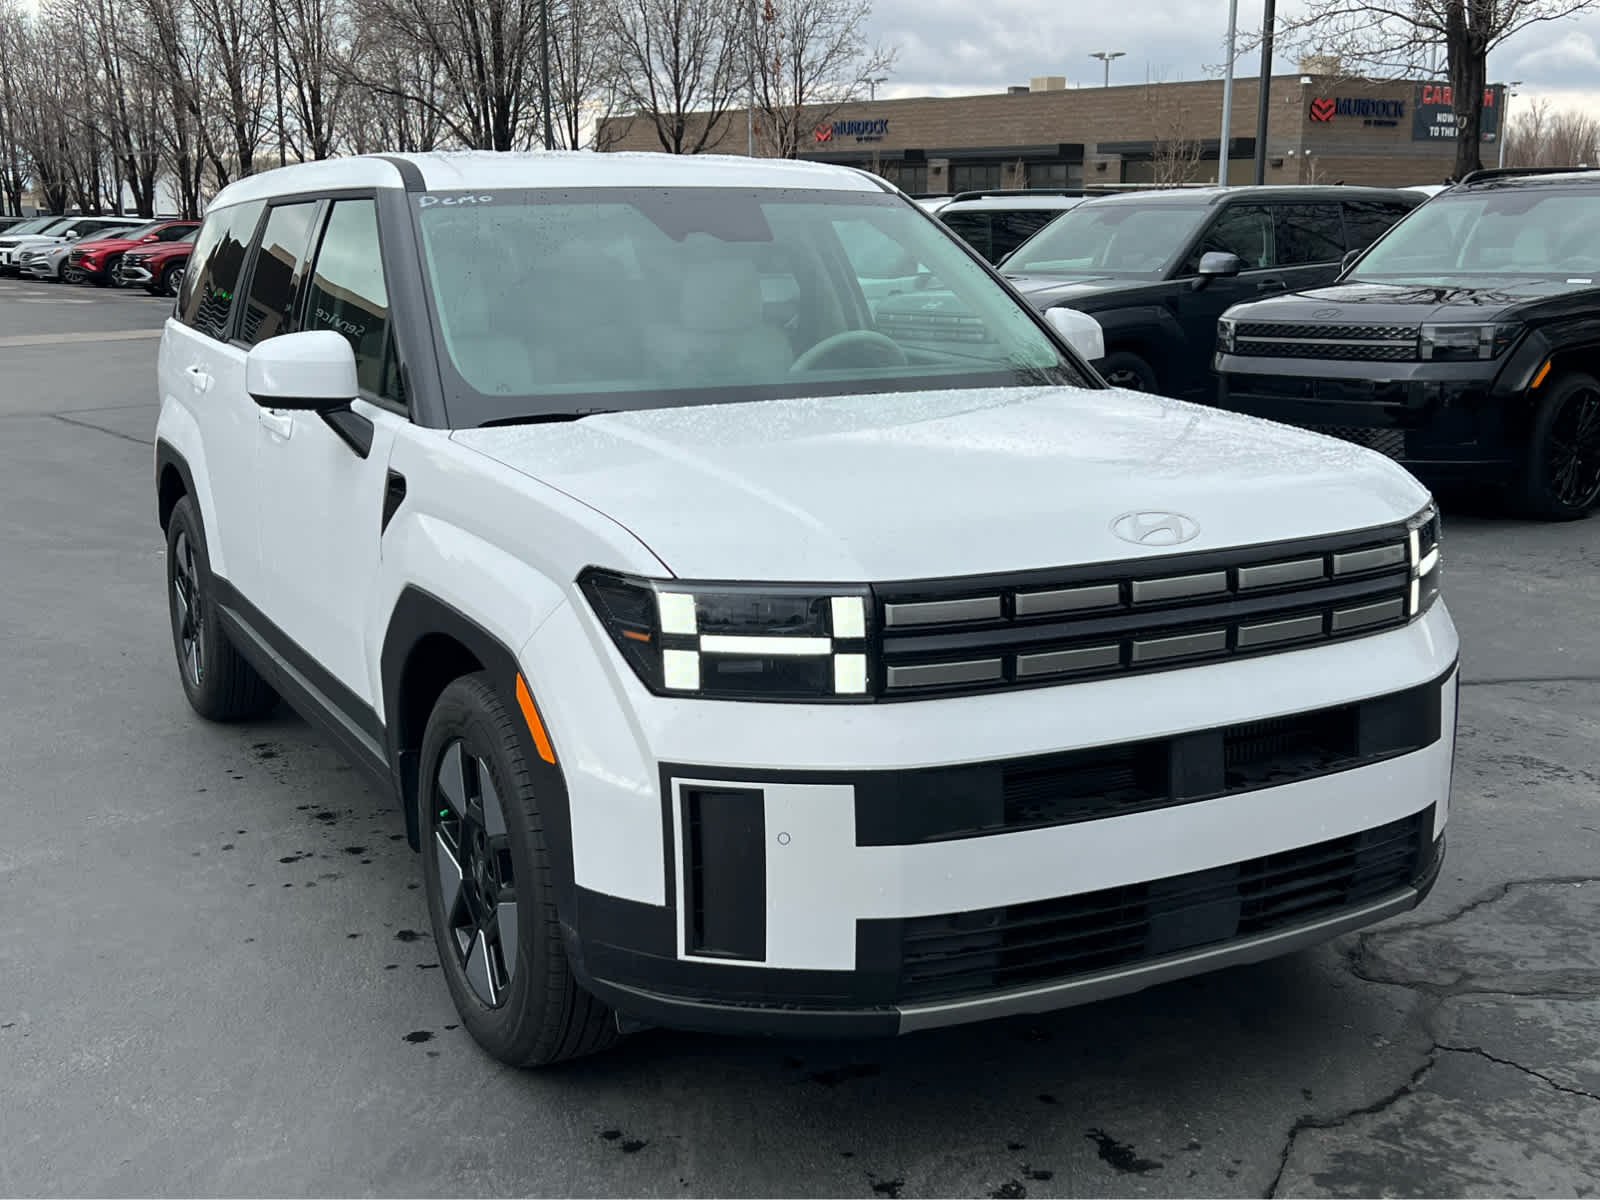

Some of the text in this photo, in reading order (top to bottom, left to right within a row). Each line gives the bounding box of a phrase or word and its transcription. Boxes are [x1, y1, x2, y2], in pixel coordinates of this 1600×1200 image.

[1423, 85, 1453, 105] CAR
[1337, 97, 1405, 119] MURDOCK
[1436, 112, 1454, 123] NOW
[832, 119, 889, 136] MURDOCK
[1429, 126, 1440, 137] TO
[1441, 126, 1455, 137] THE
